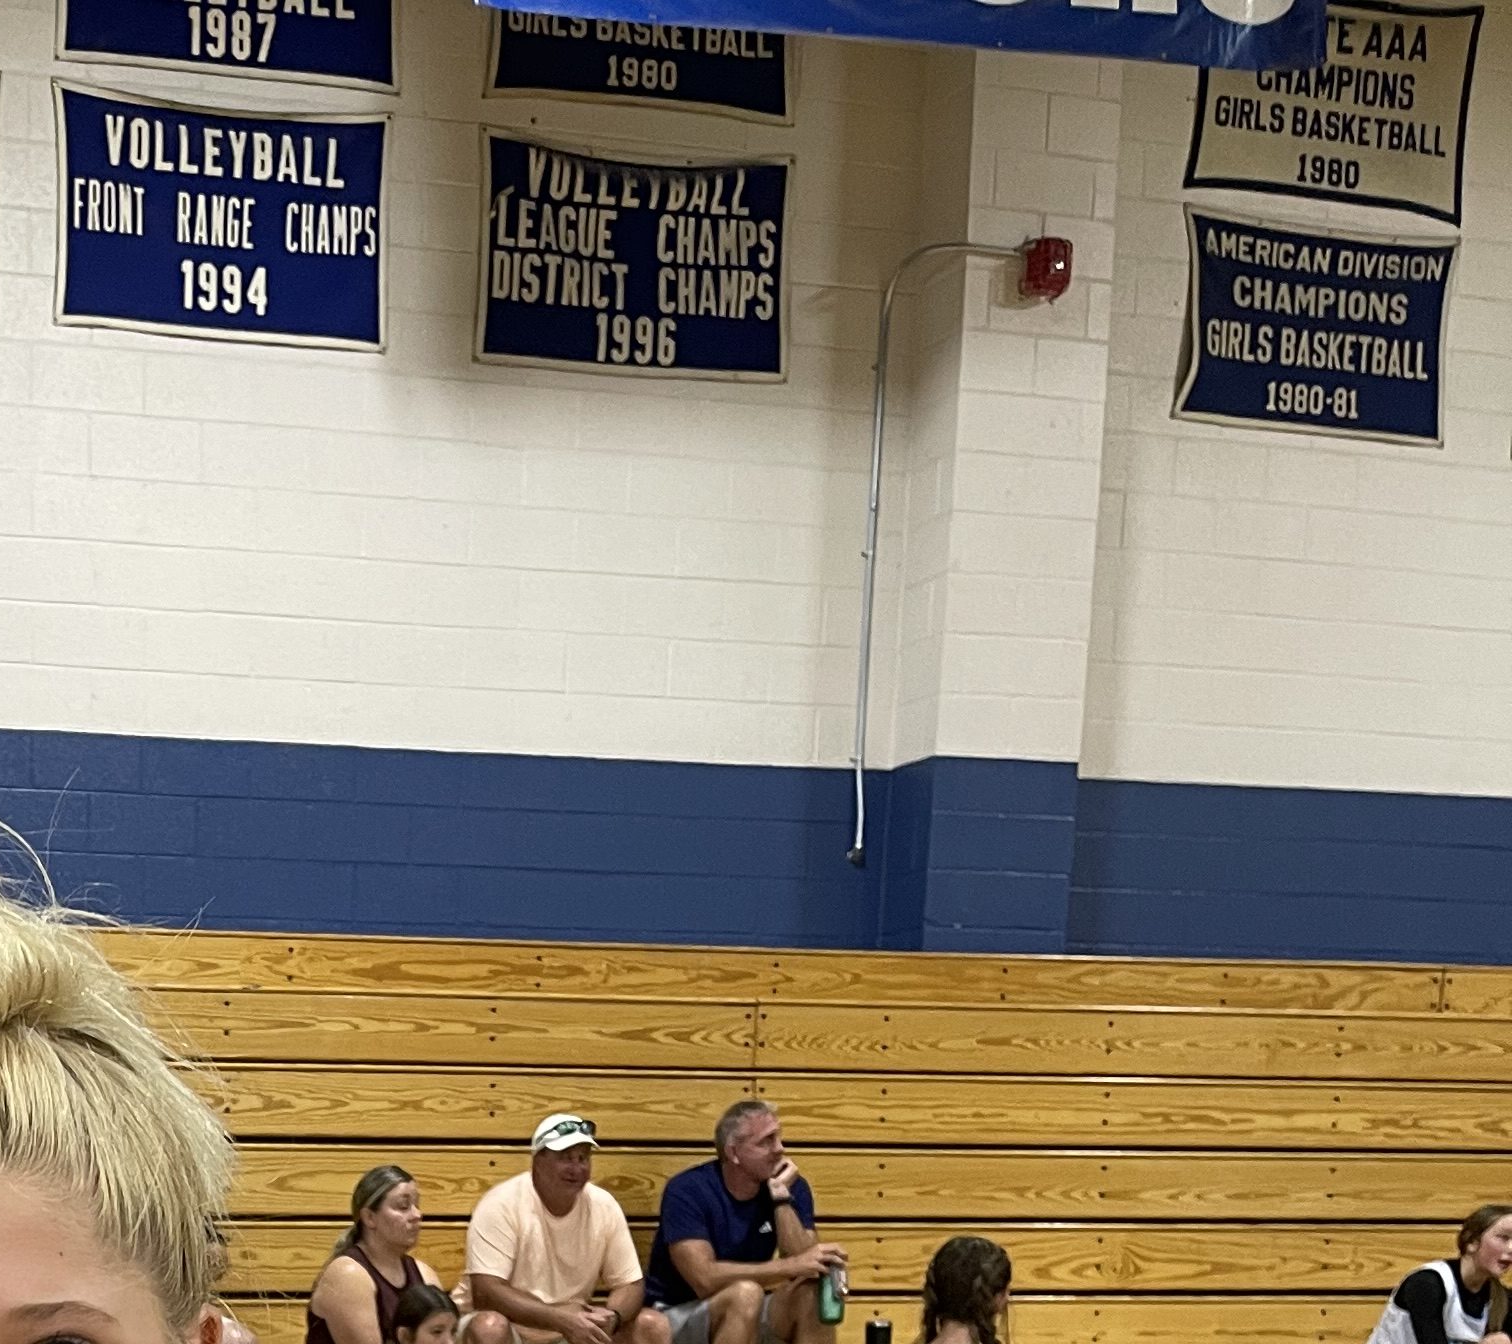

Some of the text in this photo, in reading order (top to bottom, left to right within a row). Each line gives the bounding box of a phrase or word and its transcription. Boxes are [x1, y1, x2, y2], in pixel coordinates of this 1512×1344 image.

[188, 6, 277, 63] 1987
[1362, 23, 1428, 62] AAA
[606, 54, 678, 91] 1980
[1256, 64, 1415, 111] CHAMPIONS
[105, 114, 345, 188] VOLLEYBALL
[1215, 95, 1446, 157] GIRLS BASKETBALL
[1296, 153, 1359, 189] 1980
[73, 177, 376, 257] FRONT RANGE CHAMPS
[497, 194, 776, 269] LEAGUE CHAMPS
[1205, 228, 1445, 281] AMERICAN DIVISION
[180, 259, 267, 316] 1994
[491, 251, 774, 320] DISTRICT CHAMPS
[1233, 275, 1409, 325] CHAMPIONS
[596, 312, 677, 367] 1996
[1207, 318, 1429, 381] GIRLS BASKETBALL
[1265, 381, 1358, 419] 1980-81
